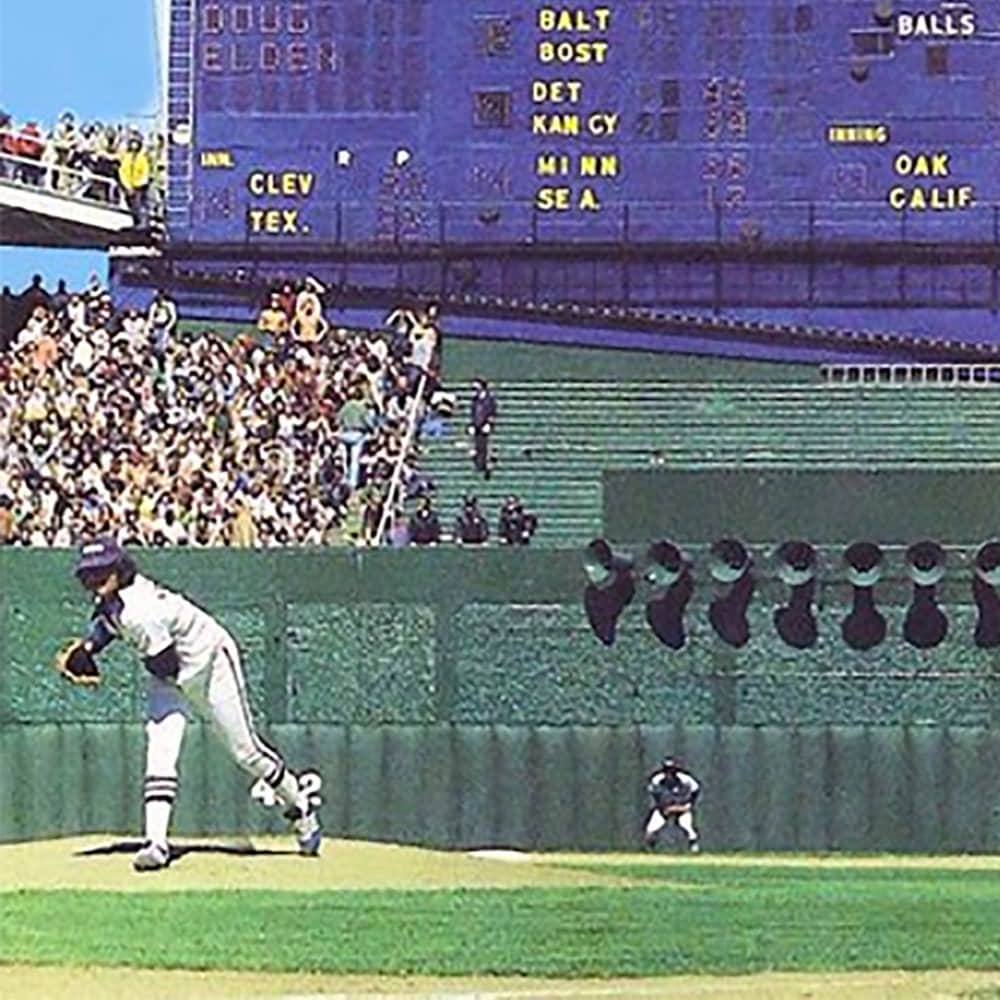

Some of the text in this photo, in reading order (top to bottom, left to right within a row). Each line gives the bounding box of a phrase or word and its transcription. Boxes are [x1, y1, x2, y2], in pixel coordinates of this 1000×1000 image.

[540, 9, 610, 31] BALT
[898, 14, 974, 35] BALLS
[540, 42, 608, 63] BOST
[533, 81, 581, 102] DET
[533, 114, 617, 135] KAN CY
[338, 150, 350, 165] R
[396, 150, 410, 165] P
[538, 156, 616, 176] MINN
[895, 154, 947, 176] OAK
[250, 173, 313, 195] CLEV
[250, 210, 309, 233] TEX.
[251, 773, 322, 806] 42
